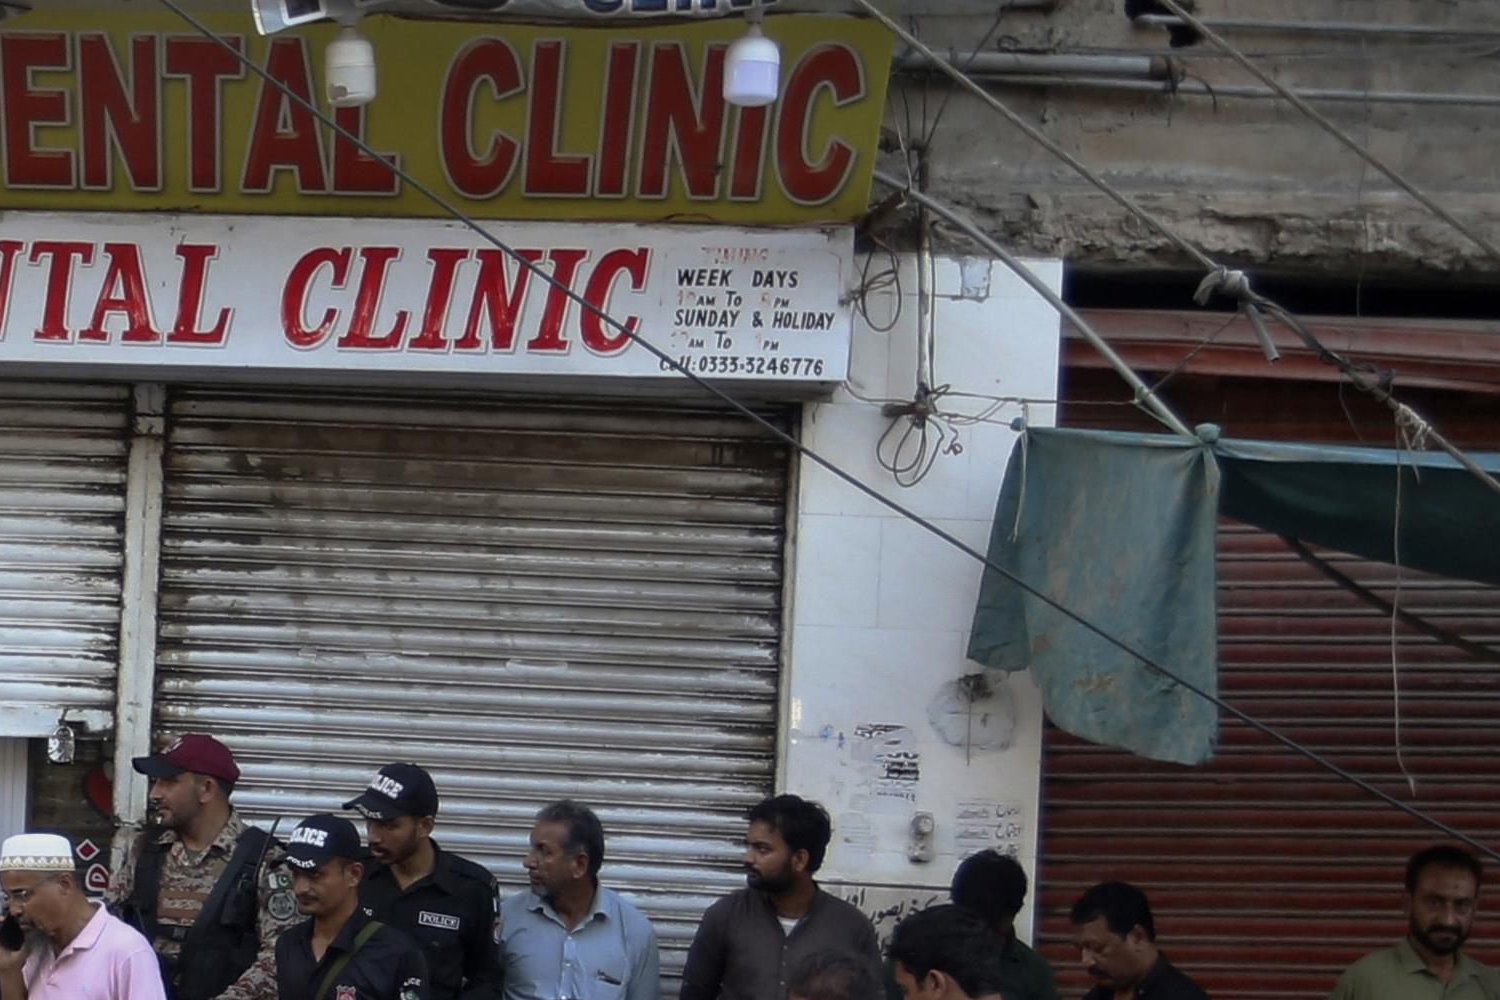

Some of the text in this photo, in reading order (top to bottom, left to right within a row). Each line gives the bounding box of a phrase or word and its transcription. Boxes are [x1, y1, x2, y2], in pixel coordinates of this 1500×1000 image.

[438, 36, 867, 205] CLINIC
[677, 268, 799, 289] WEEK DAYS
[280, 245, 654, 356] CLINIC
[673, 308, 836, 331] SUNDAY & HOLIDAY
[422, 912, 457, 927] POLICE
